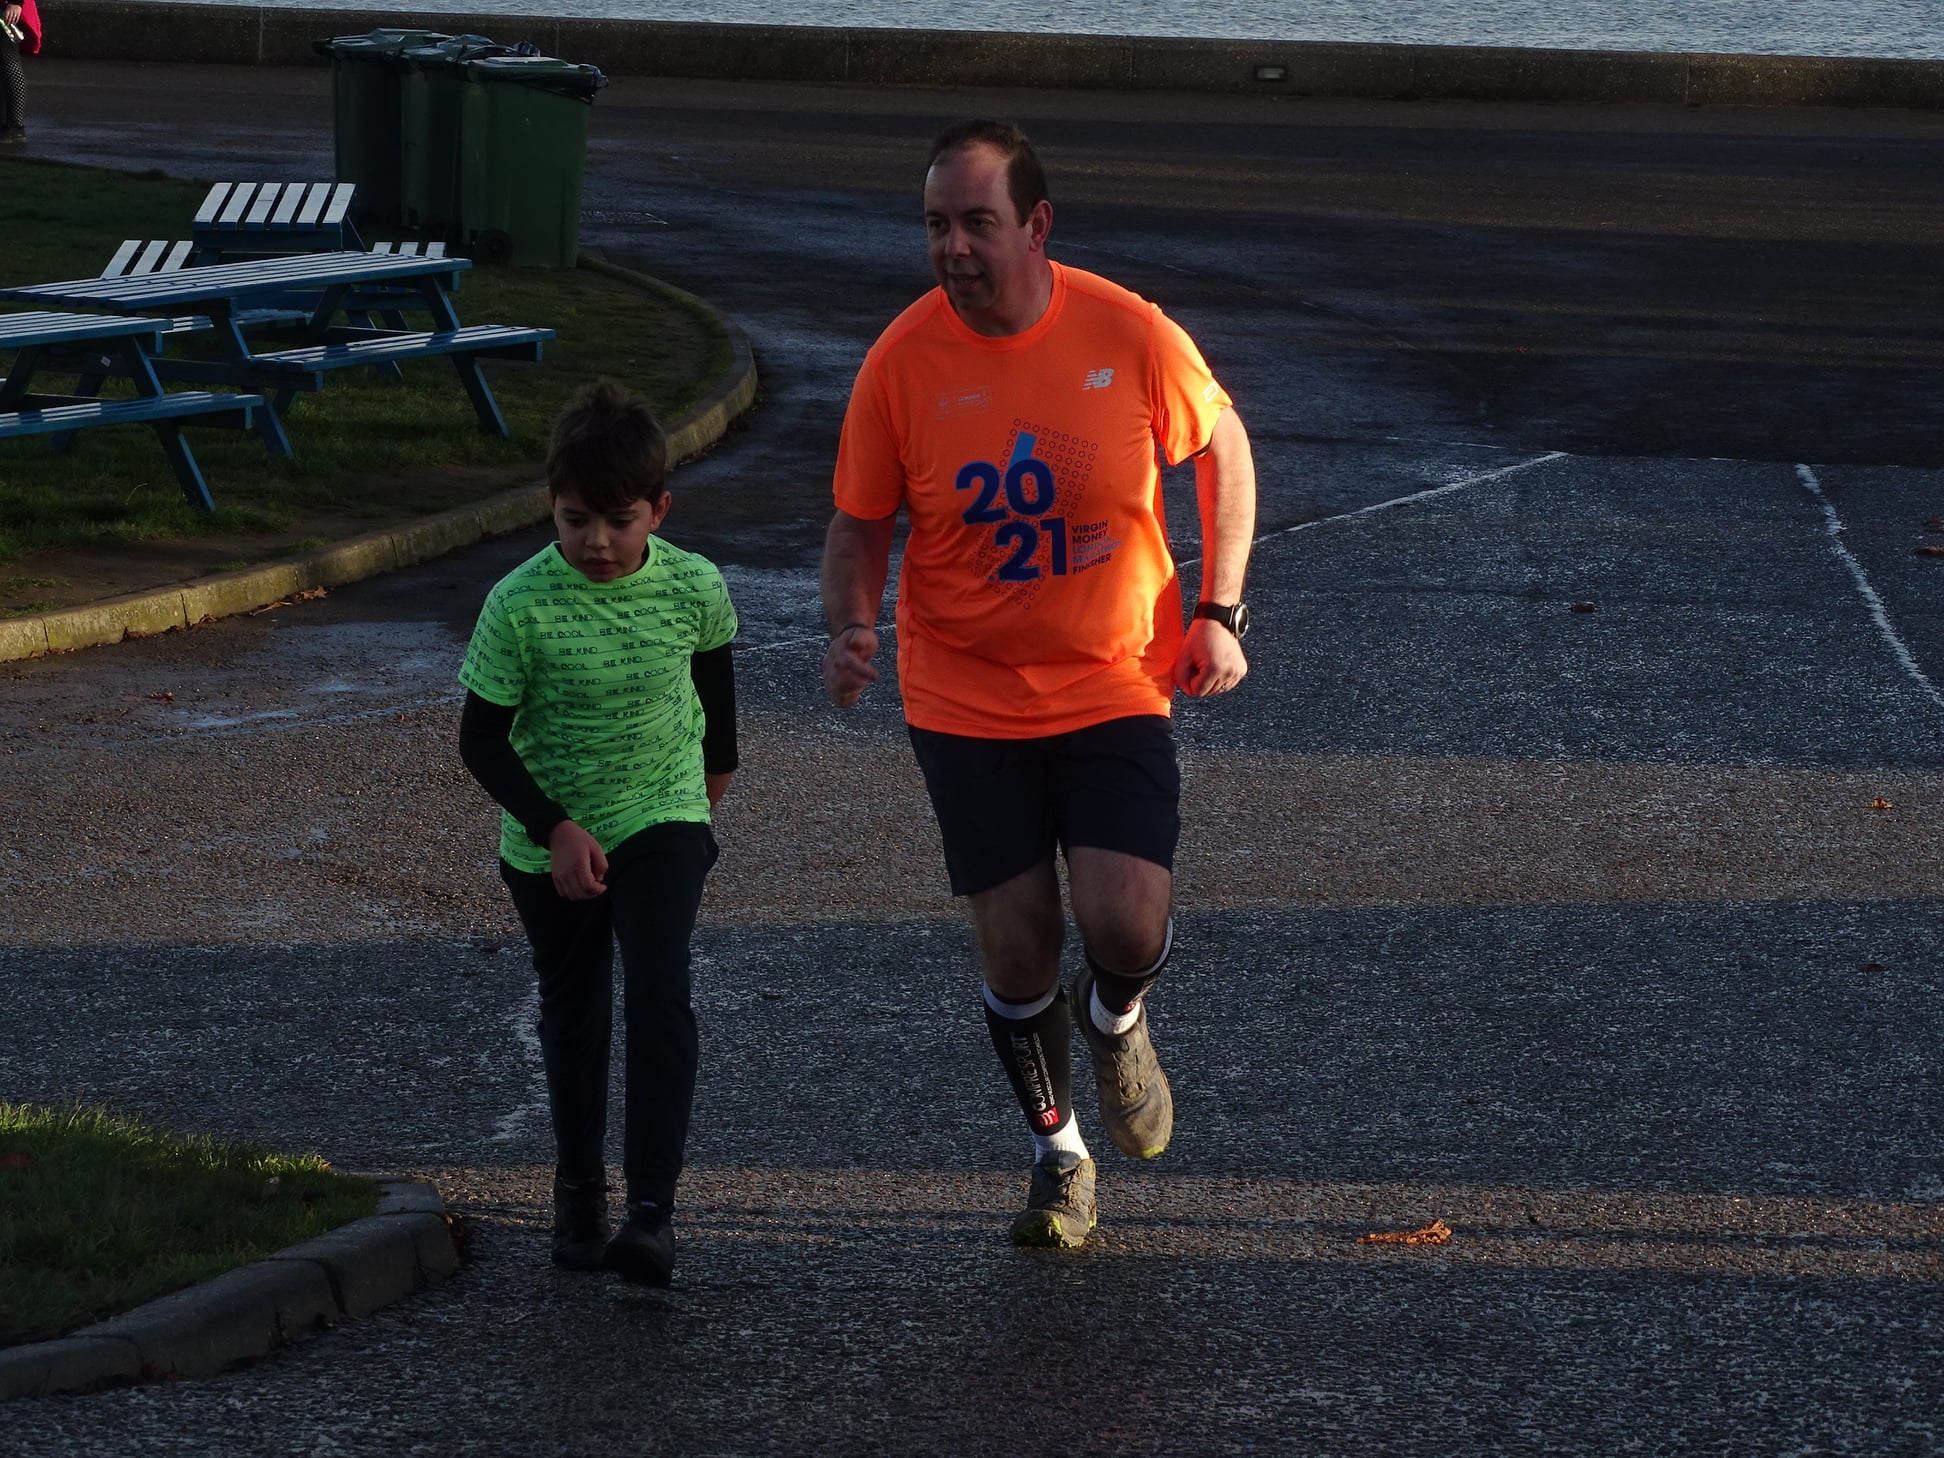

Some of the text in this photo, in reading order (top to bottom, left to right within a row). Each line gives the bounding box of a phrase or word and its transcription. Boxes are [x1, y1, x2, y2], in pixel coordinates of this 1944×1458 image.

[1072, 519, 1109, 534] VIRGIN
[1072, 529, 1108, 544] MONEY
[1072, 553, 1111, 575] FINISHER
[683, 568, 703, 578] KIND
[655, 589, 668, 597] BE
[672, 585, 699, 595] COOL
[535, 595, 632, 607] BE COOL BE KIND
[555, 615, 568, 623] BE
[572, 613, 594, 622] KIND
[617, 611, 630, 620] BE
[634, 606, 659, 617] COOL
[673, 602, 686, 610] BE
[690, 600, 711, 609] KIND
[540, 614, 699, 640] BE COOL BE KIND BE COOL
[559, 648, 572, 656] BE
[576, 646, 598, 655] KIND
[622, 642, 635, 650] BE
[640, 638, 666, 648] COOL
[561, 663, 588, 671] COOL
[603, 659, 617, 668] BE
[620, 656, 643, 665] KIND
[579, 678, 601, 687] KIND
[626, 673, 639, 681] BE
[644, 666, 669, 678] COOL
[605, 688, 619, 696] BE
[623, 685, 645, 694] KIND
[627, 700, 640, 708] BE
[605, 711, 619, 720] BE
[623, 709, 645, 719] KIND
